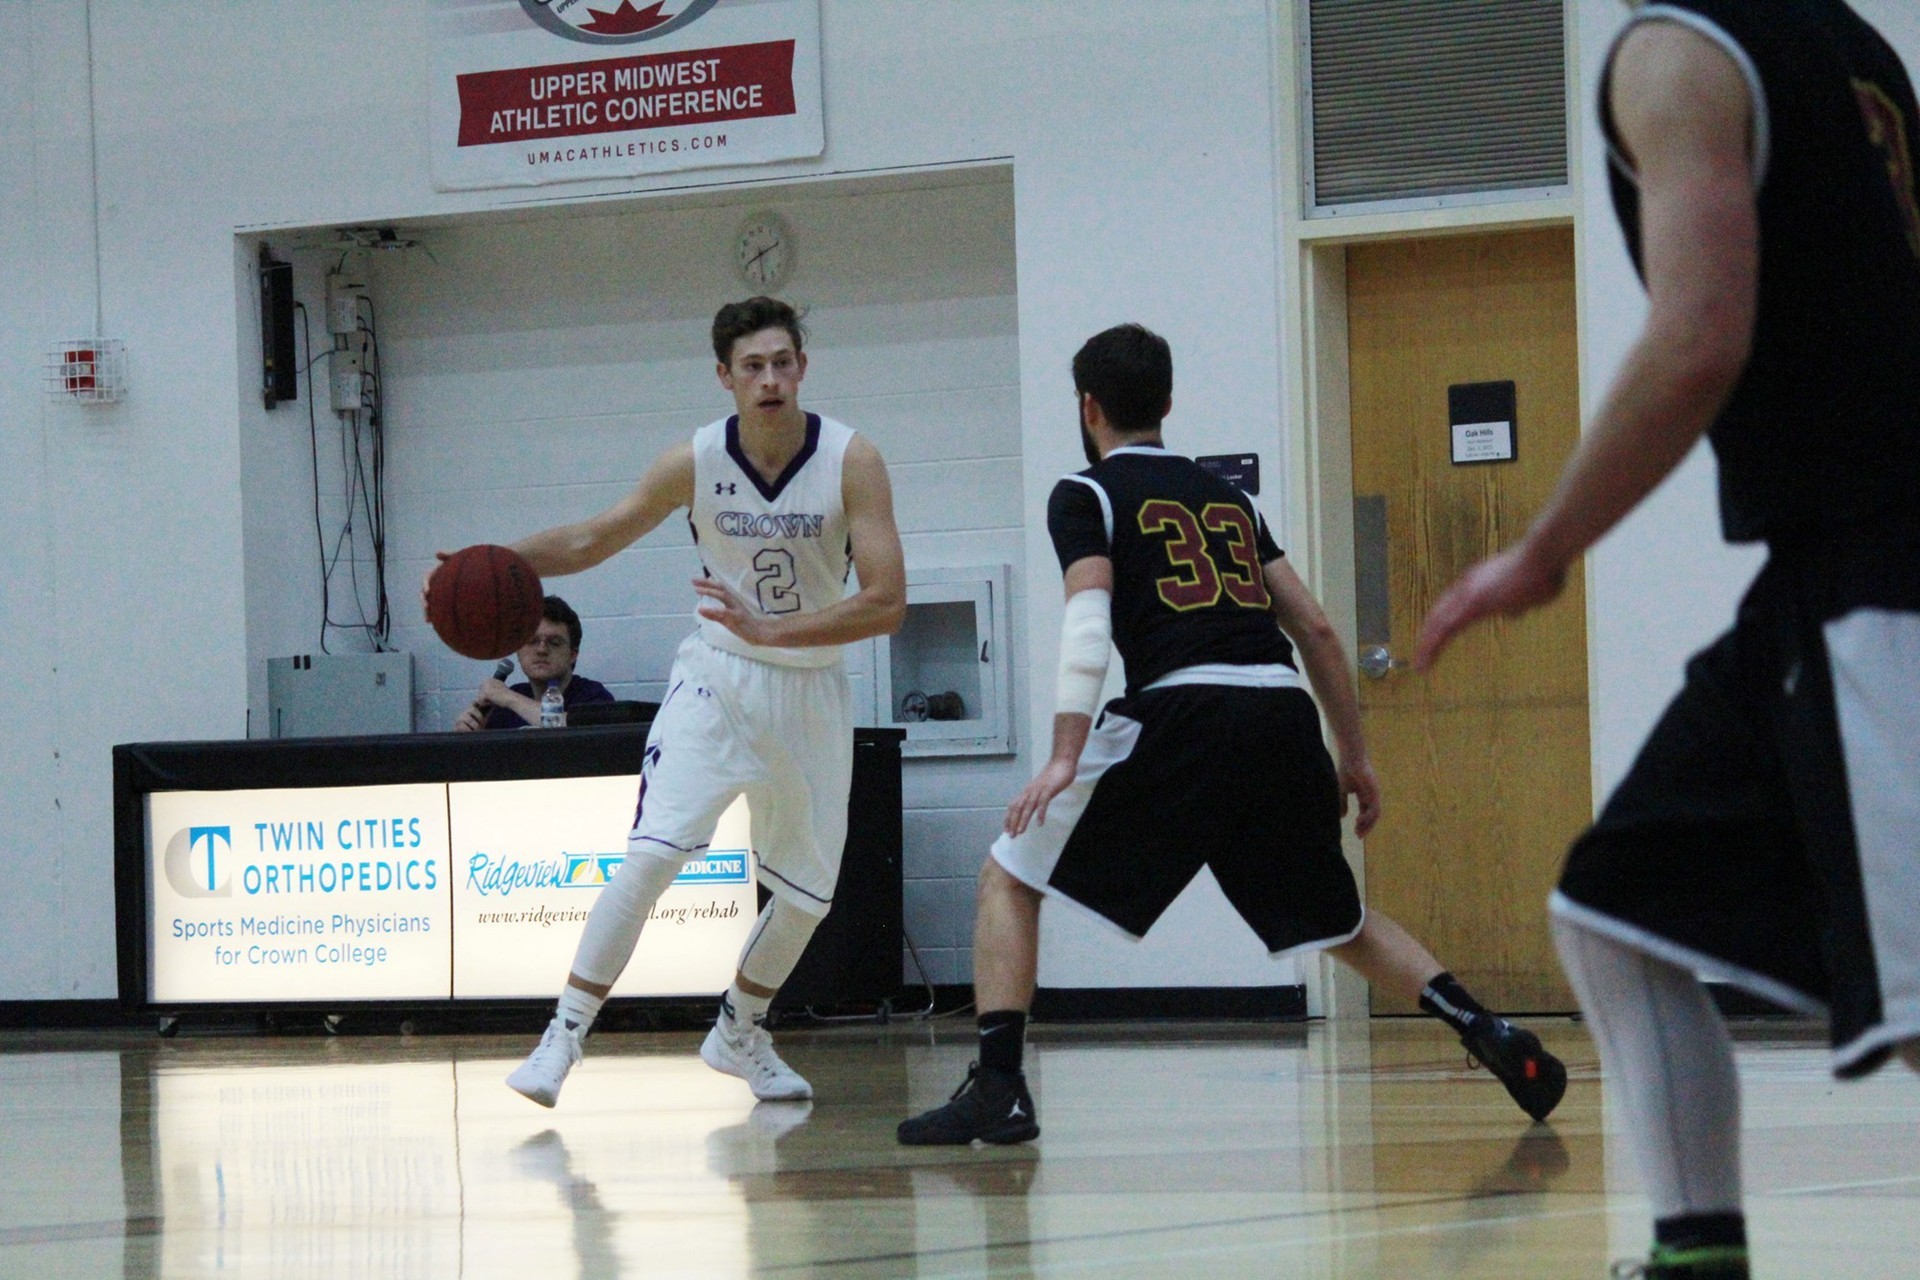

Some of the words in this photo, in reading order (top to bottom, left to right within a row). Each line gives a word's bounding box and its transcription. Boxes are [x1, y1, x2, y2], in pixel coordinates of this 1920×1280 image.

[530, 71, 607, 100] UPPER
[615, 59, 721, 92] MIDWEST
[490, 101, 598, 134] ATHLETIC
[605, 85, 763, 122] CONFERENCE
[527, 135, 727, 165] UMACATHLETICS.COM
[715, 511, 824, 538] CROWN
[1137, 499, 1271, 612] 33
[753, 548, 801, 614] 2
[254, 820, 323, 851] TWIN
[337, 817, 421, 850] CITIES
[243, 859, 437, 894] ORTHOPEDICS
[466, 851, 568, 896] Ridgeview
[679, 860, 742, 874] EDICINE
[172, 917, 234, 941] Sports
[240, 915, 324, 937] Medicine
[332, 912, 431, 937] Physicians
[215, 946, 241, 965] for
[248, 945, 308, 965] Crown
[315, 943, 387, 966] College
